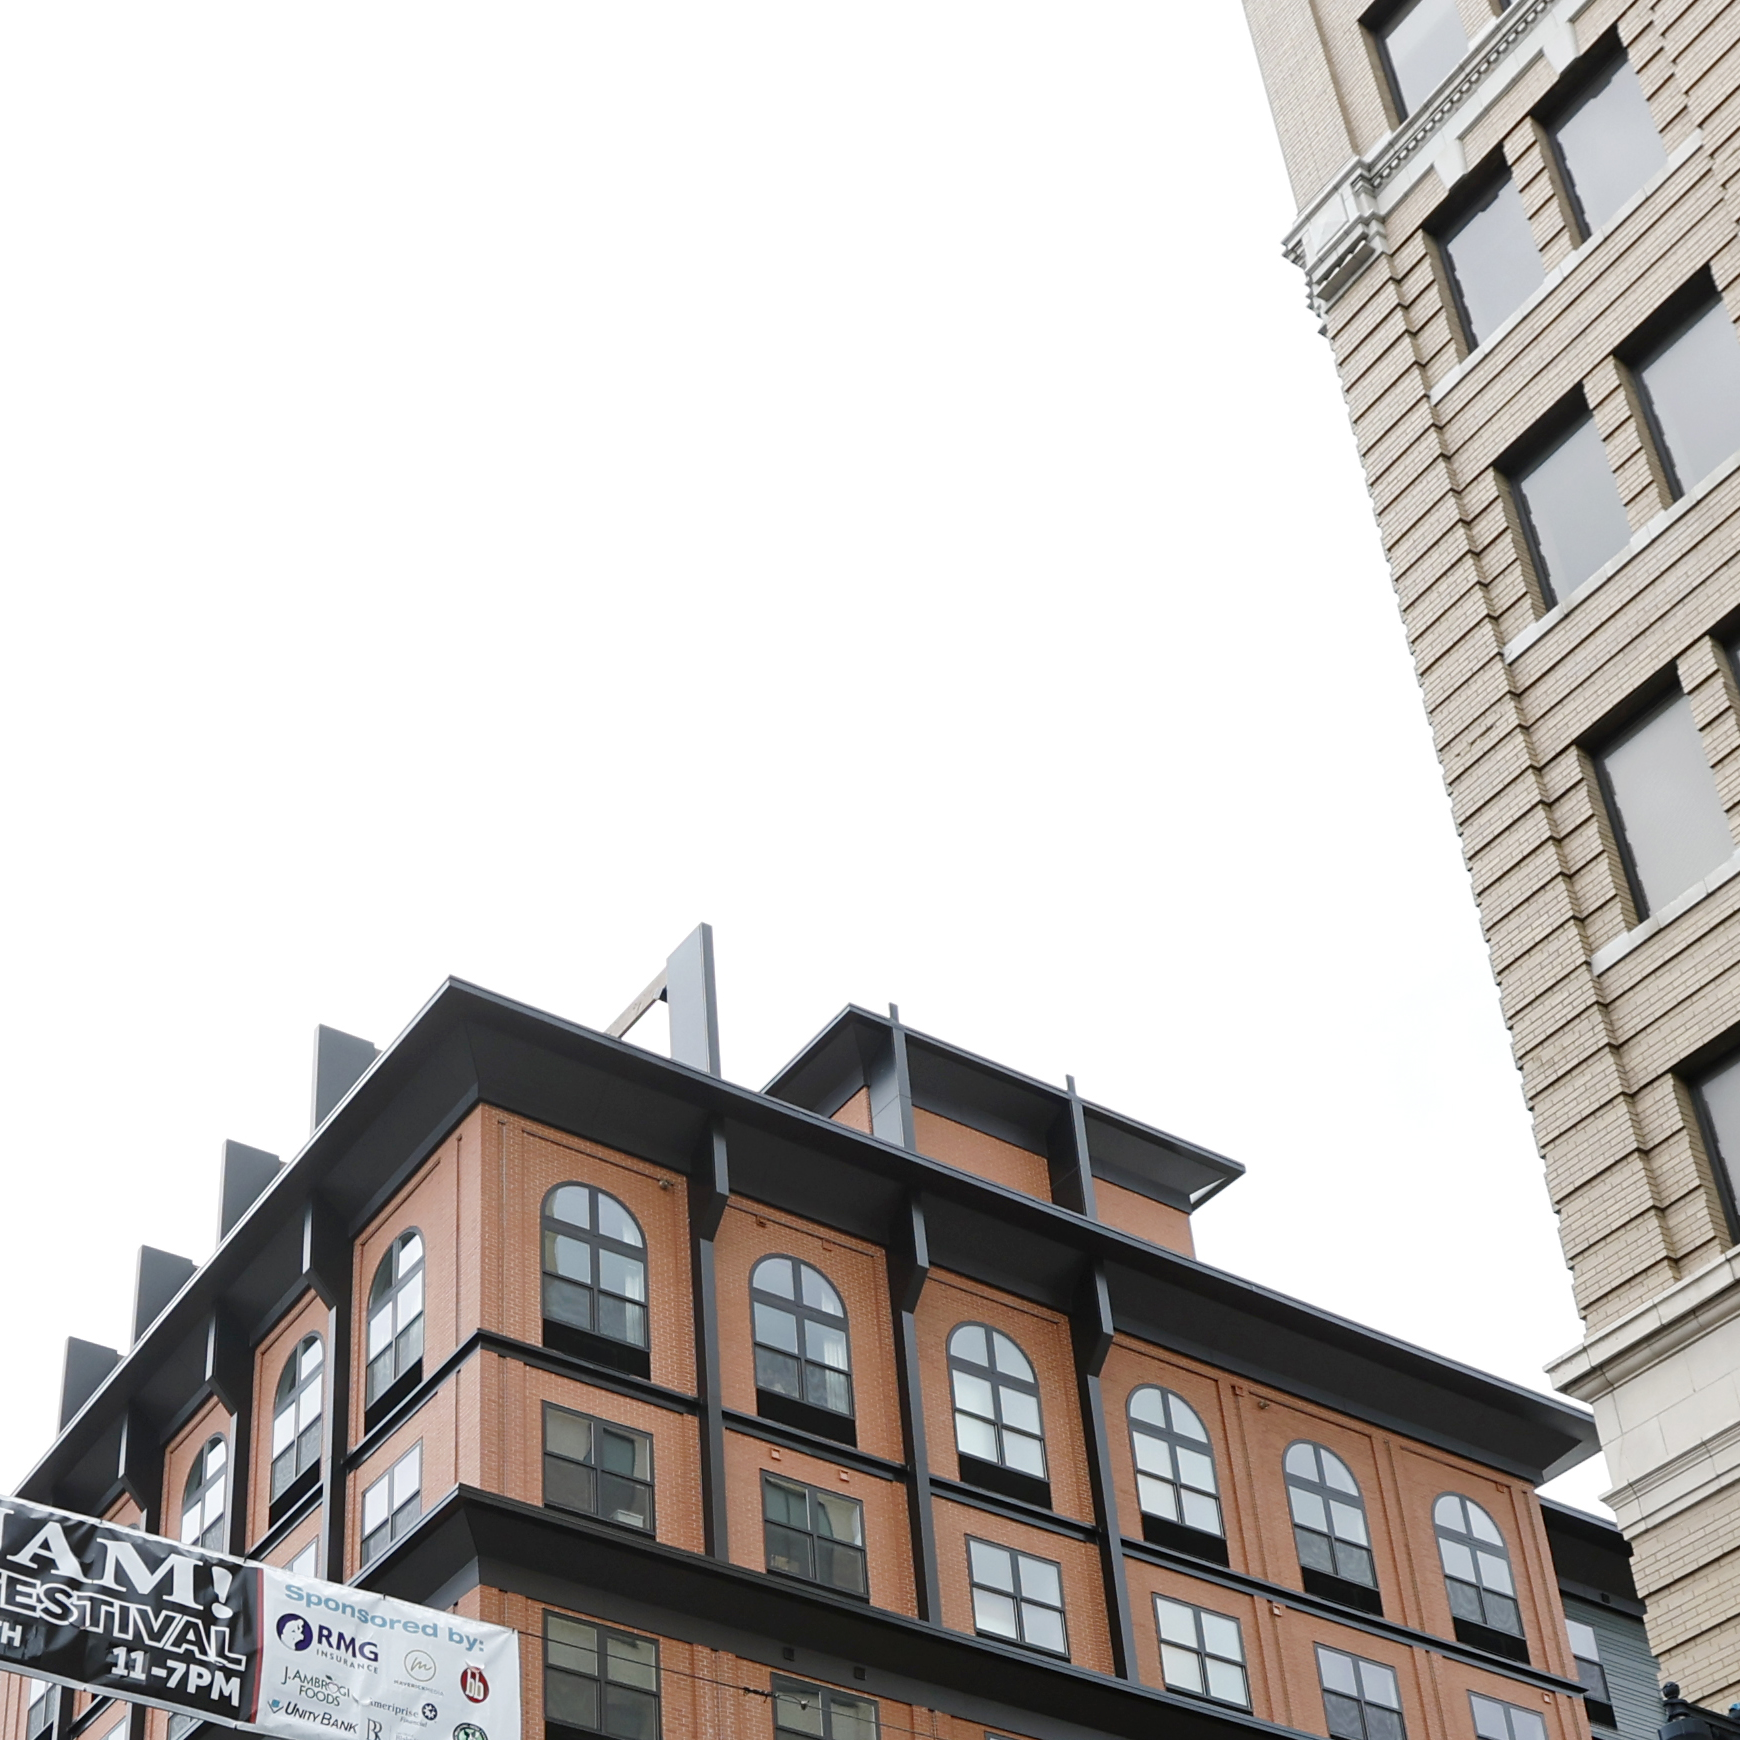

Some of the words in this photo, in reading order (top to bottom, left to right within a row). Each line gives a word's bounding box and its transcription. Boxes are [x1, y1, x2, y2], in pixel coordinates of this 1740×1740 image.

[285, 1583, 439, 1638] Sponsored
[448, 1627, 485, 1652] by:
[317, 1624, 380, 1663] RMG
[111, 1645, 242, 1708] 11-7PM
[316, 1648, 380, 1675] INSURANCE
[298, 1684, 341, 1707] FOODS
[400, 1715, 428, 1729] Financial
